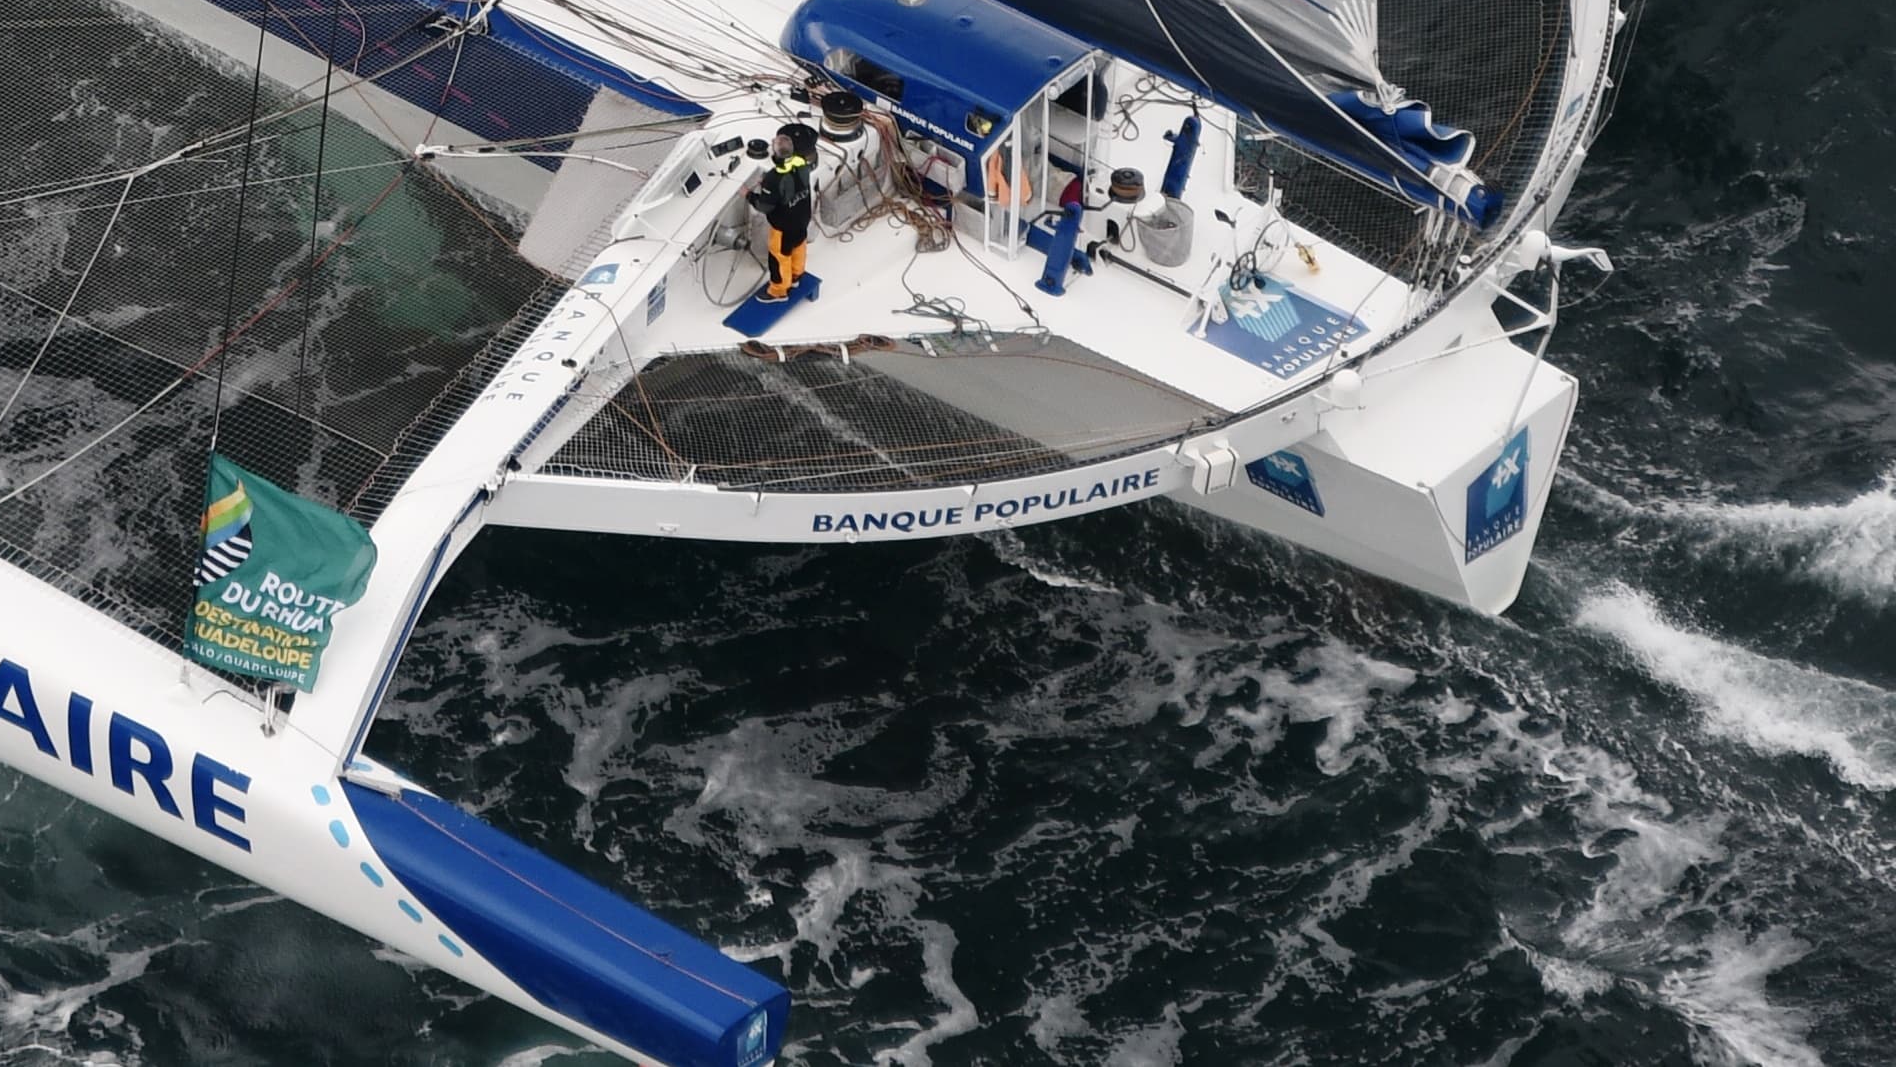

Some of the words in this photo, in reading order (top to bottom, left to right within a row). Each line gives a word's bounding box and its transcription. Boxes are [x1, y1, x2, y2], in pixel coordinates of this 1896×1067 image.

[891, 104, 927, 129] BANQUE
[927, 122, 975, 152] POPULAIRE
[506, 292, 602, 400] BANQUE
[1261, 316, 1341, 369] BANQUE
[1276, 325, 1359, 376] POPULAIRE
[811, 505, 964, 533] BANQUE
[973, 467, 1161, 522] POPULAIRE
[1466, 517, 1521, 561] POPULAIRE
[221, 581, 262, 613] DU
